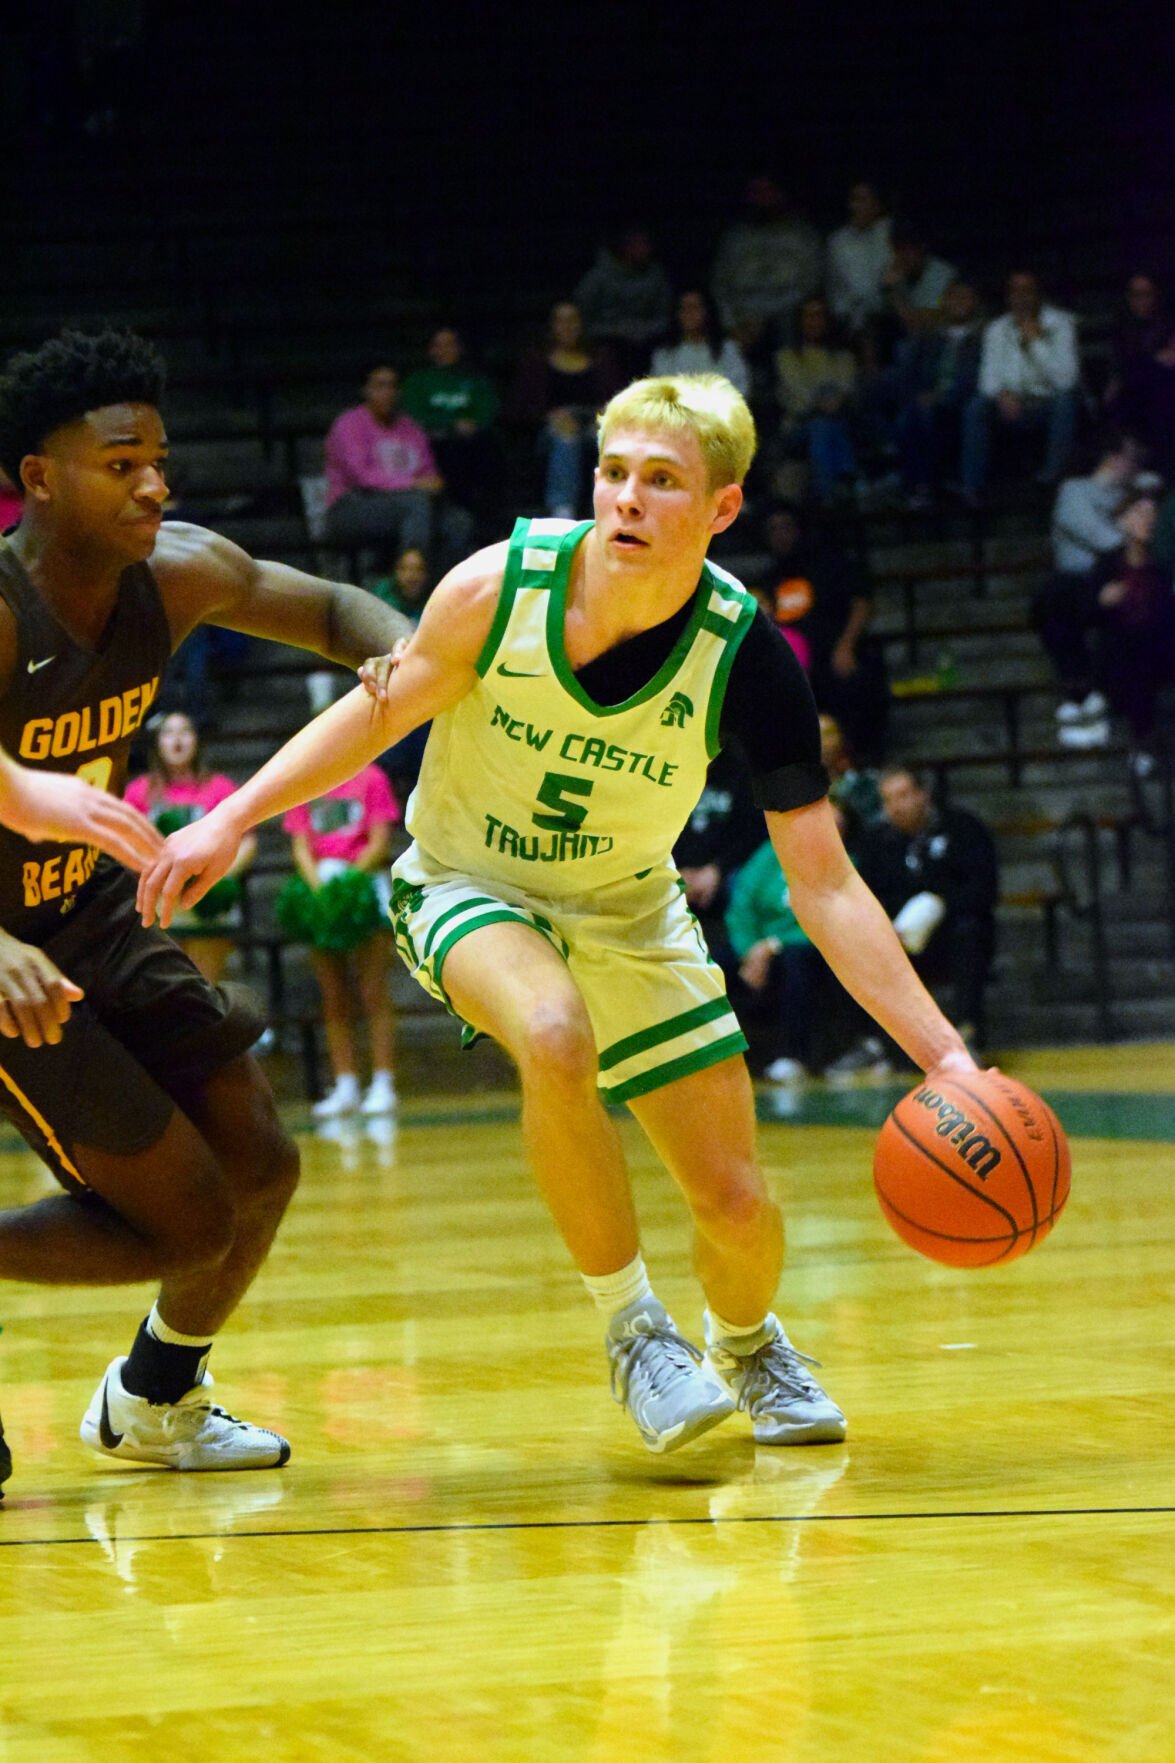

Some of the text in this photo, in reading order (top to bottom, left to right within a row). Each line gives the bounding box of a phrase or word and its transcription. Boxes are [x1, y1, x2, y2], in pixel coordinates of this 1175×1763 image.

[18, 676, 159, 760] GOLDEN
[490, 704, 679, 787] NEW CASTLE
[531, 771, 595, 833] 5
[912, 1087, 1002, 1182] Wilson
